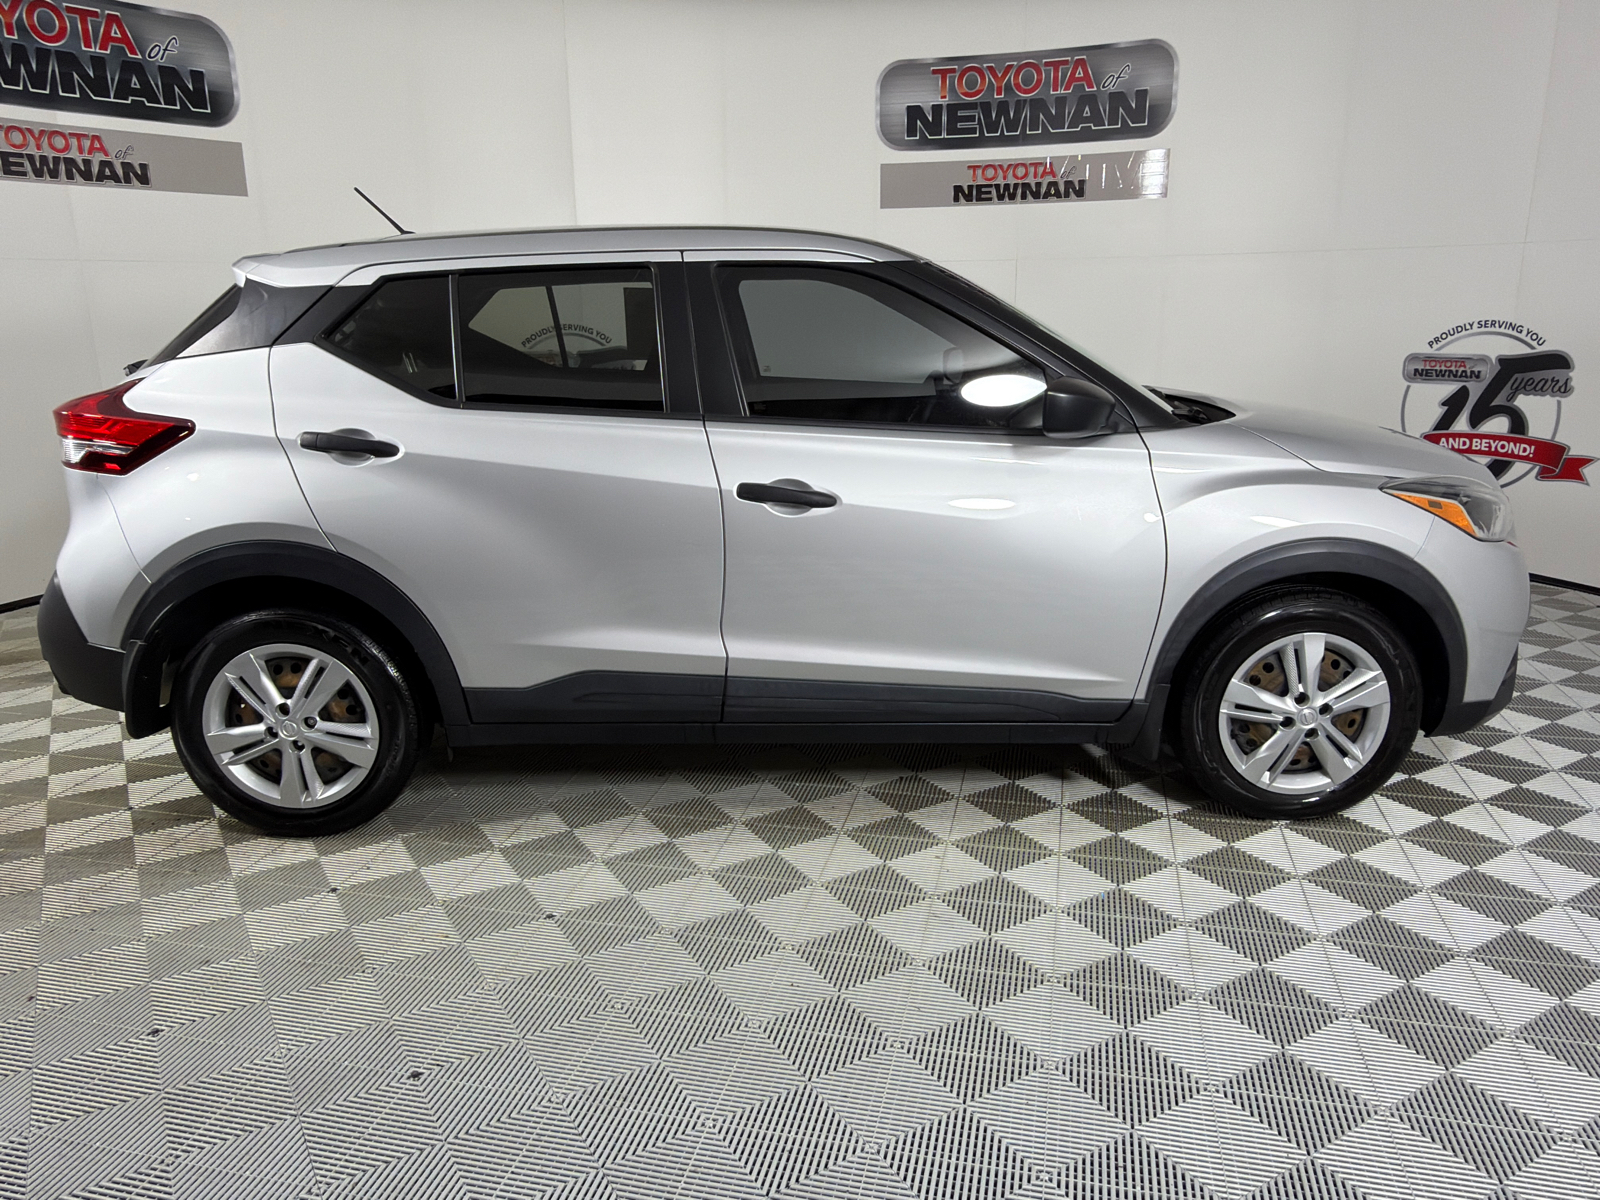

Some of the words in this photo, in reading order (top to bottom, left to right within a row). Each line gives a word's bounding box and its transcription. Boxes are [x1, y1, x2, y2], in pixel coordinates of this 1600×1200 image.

[147, 36, 178, 62] of
[931, 55, 1097, 100] TOYOTA
[1101, 63, 1131, 91] of
[904, 88, 1150, 140] NEWNAN
[0, 124, 111, 159] OYOTA
[114, 144, 135, 160] of
[967, 161, 1057, 182] TOYOTA
[952, 179, 1086, 203] NEWNAN
[560, 323, 594, 336] ERVING
[596, 330, 613, 345] YOU
[1427, 320, 1475, 349] PROUDLY
[1477, 319, 1524, 335] SERVING
[1525, 328, 1547, 347] YOU
[1413, 368, 1482, 380] NEWNAN
[1422, 358, 1467, 369] TOYOTA
[1432, 353, 1571, 480] 15
[1506, 374, 1572, 403] years
[1439, 437, 1470, 451] AND
[1471, 438, 1536, 458] BEYOND!
